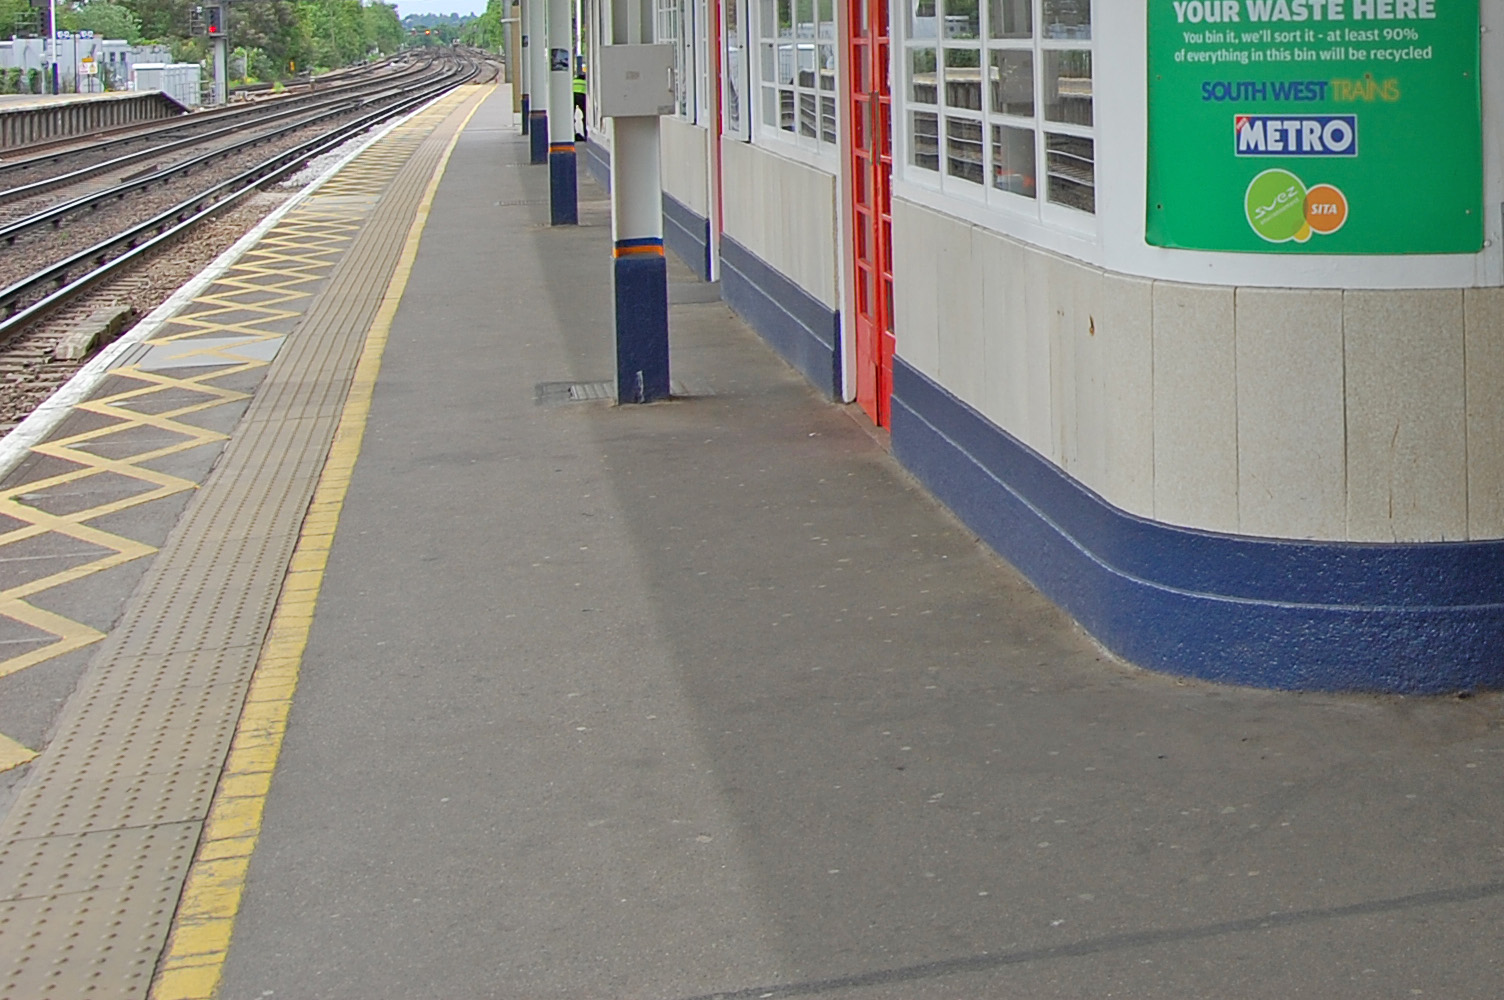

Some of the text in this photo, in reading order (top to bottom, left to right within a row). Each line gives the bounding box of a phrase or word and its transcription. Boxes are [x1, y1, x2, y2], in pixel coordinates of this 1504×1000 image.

[1173, 0, 1240, 23] YOUR
[1183, 31, 1203, 44] You
[1205, 31, 1224, 43] bin
[1226, 31, 1239, 45] it,
[1242, 30, 1271, 43] we'll
[1274, 30, 1302, 42] sort
[1304, 30, 1315, 42] it
[1326, 30, 1341, 41] at
[1345, 28, 1379, 41] least
[1383, 28, 1418, 41] 90%
[1174, 46, 1432, 64] of everything in this bin will be recycled
[1202, 81, 1266, 101] SOUTH
[1273, 81, 1327, 101] WEST
[1238, 120, 1352, 151] METRO
[1254, 186, 1298, 219] suez
[1311, 204, 1337, 215] SITA
